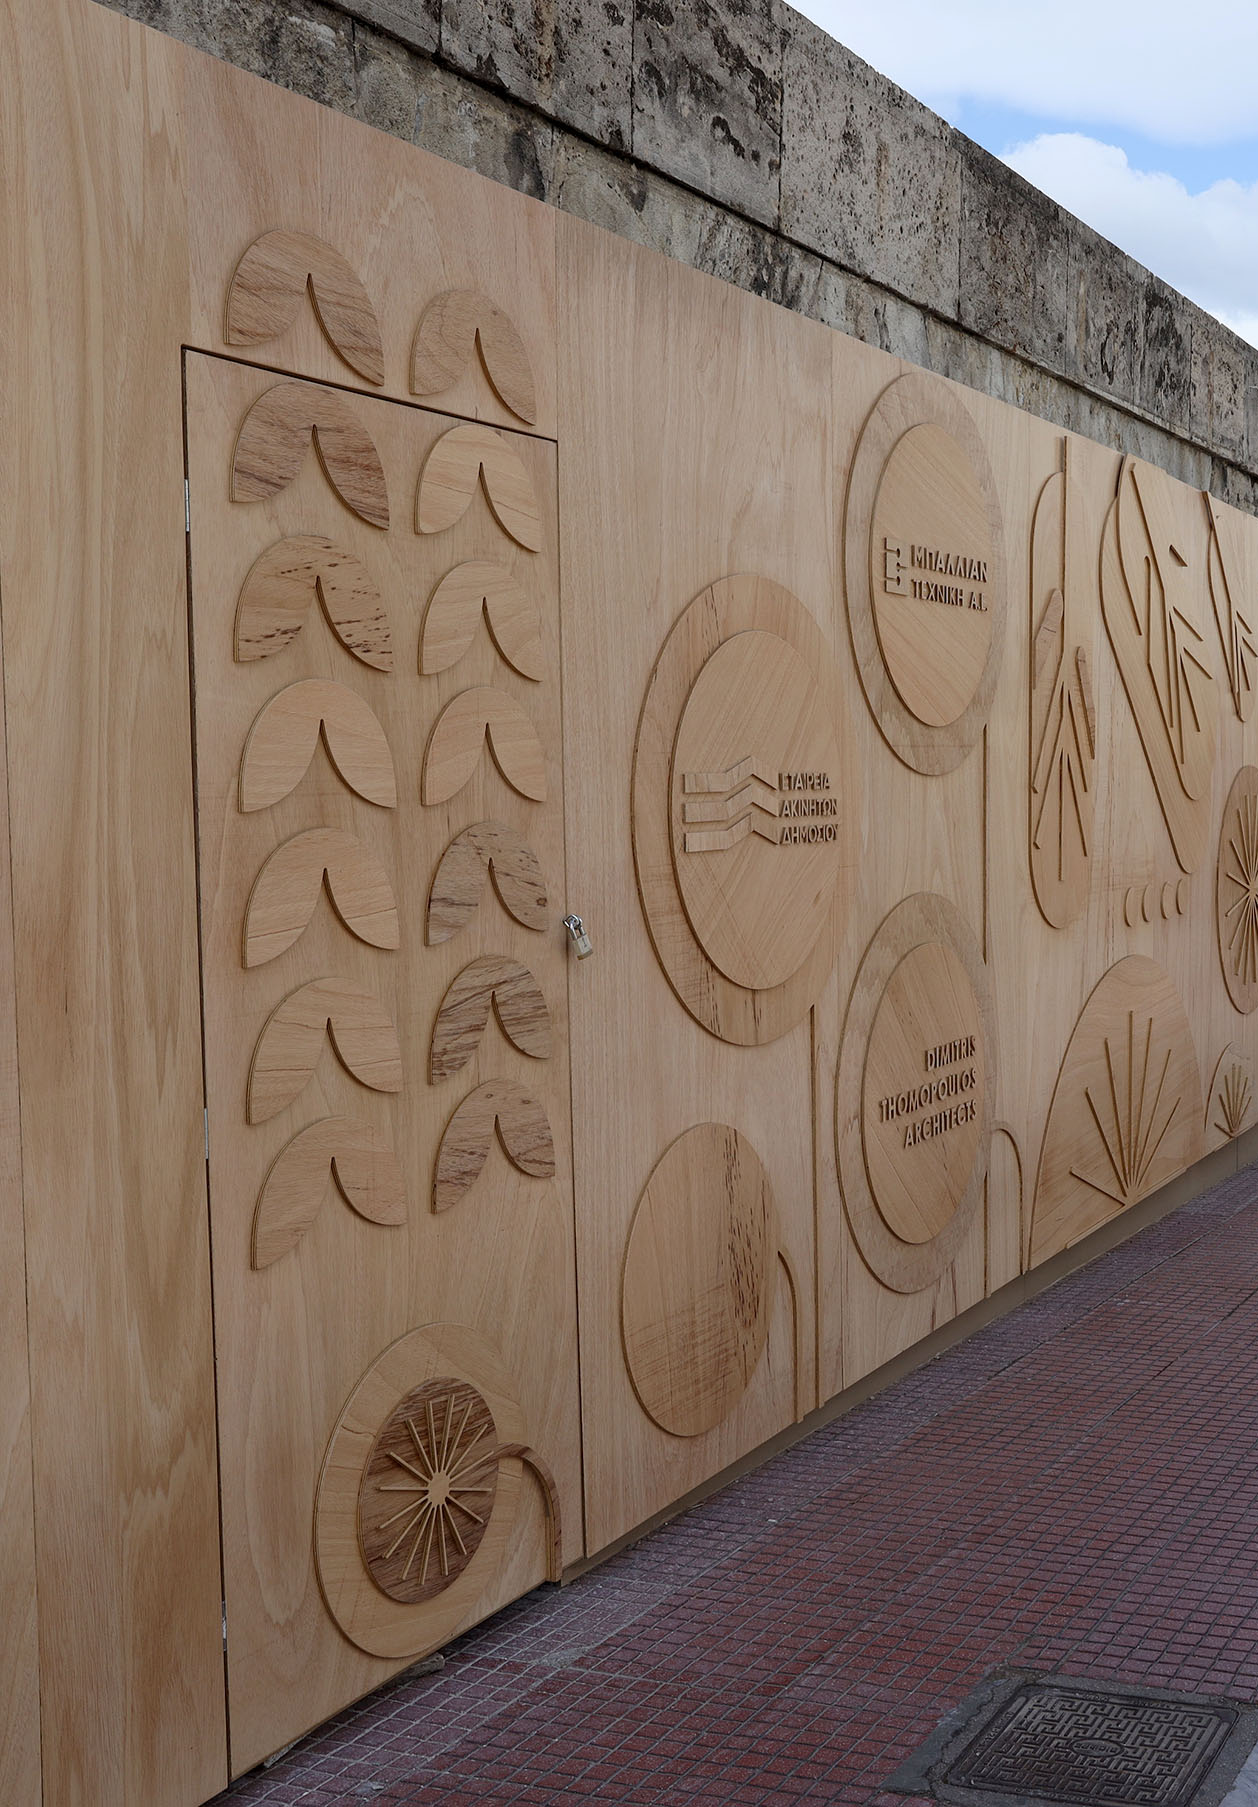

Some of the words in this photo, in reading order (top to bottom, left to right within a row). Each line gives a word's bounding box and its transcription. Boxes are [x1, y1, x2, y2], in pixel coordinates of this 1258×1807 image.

[911, 544, 987, 583] ΜΠΑΛΛΙΑΝ
[911, 579, 964, 607] ΤΕΧΝΙΚΗ
[778, 772, 830, 791] ΕΤΑΙΡΕΙΑ
[779, 798, 838, 818] ΑΚΙΝΗΤΩΝ
[779, 823, 839, 845] ΔΗΜΟΣΙΟΥ
[925, 1035, 976, 1072] DIMITRIS
[879, 1067, 976, 1123] THOMOPOULOS
[904, 1098, 976, 1149] ARCHITECTS
